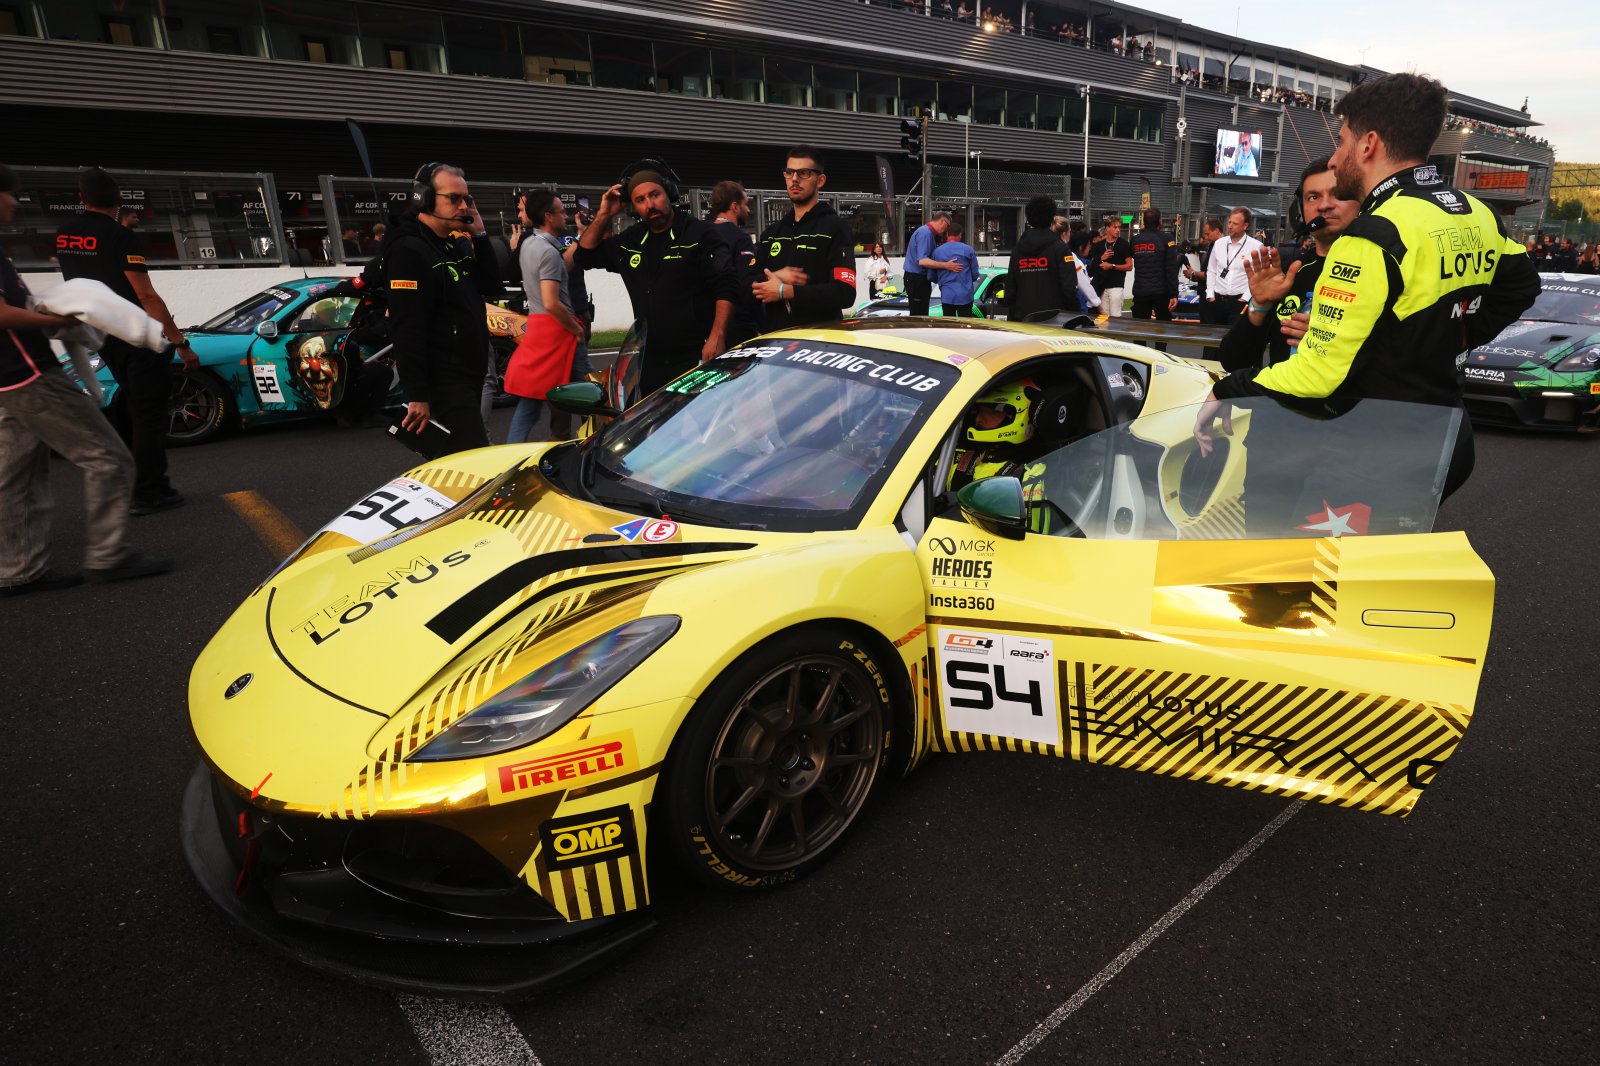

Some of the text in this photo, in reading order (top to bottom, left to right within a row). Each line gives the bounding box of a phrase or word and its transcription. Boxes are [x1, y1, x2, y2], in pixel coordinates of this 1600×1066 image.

[286, 192, 301, 200] 71
[56, 234, 97, 250] SRO
[1428, 226, 1484, 253] TEAM
[201, 248, 215, 258] 19
[1018, 256, 1048, 269] SRO
[1440, 249, 1496, 280] LOTUS
[841, 271, 855, 281] SR
[1331, 265, 1360, 280] OMP
[1319, 286, 1356, 303] PIRELLI
[1541, 284, 1579, 293] ACING
[786, 349, 870, 373] RACING
[868, 363, 941, 392] CLUB
[256, 376, 279, 394] 32
[959, 540, 996, 552] MGK
[931, 557, 993, 579] HEROES
[931, 578, 989, 588] VALLEY
[290, 555, 431, 634] TEAM
[308, 550, 472, 646] LOTUS
[930, 593, 995, 611] Insta360
[838, 640, 889, 703] P ZERO
[1147, 693, 1243, 722] LOTUS
[498, 740, 625, 794] PIRELLI
[553, 822, 622, 855] OMP
[690, 836, 764, 888] PIRELLI
